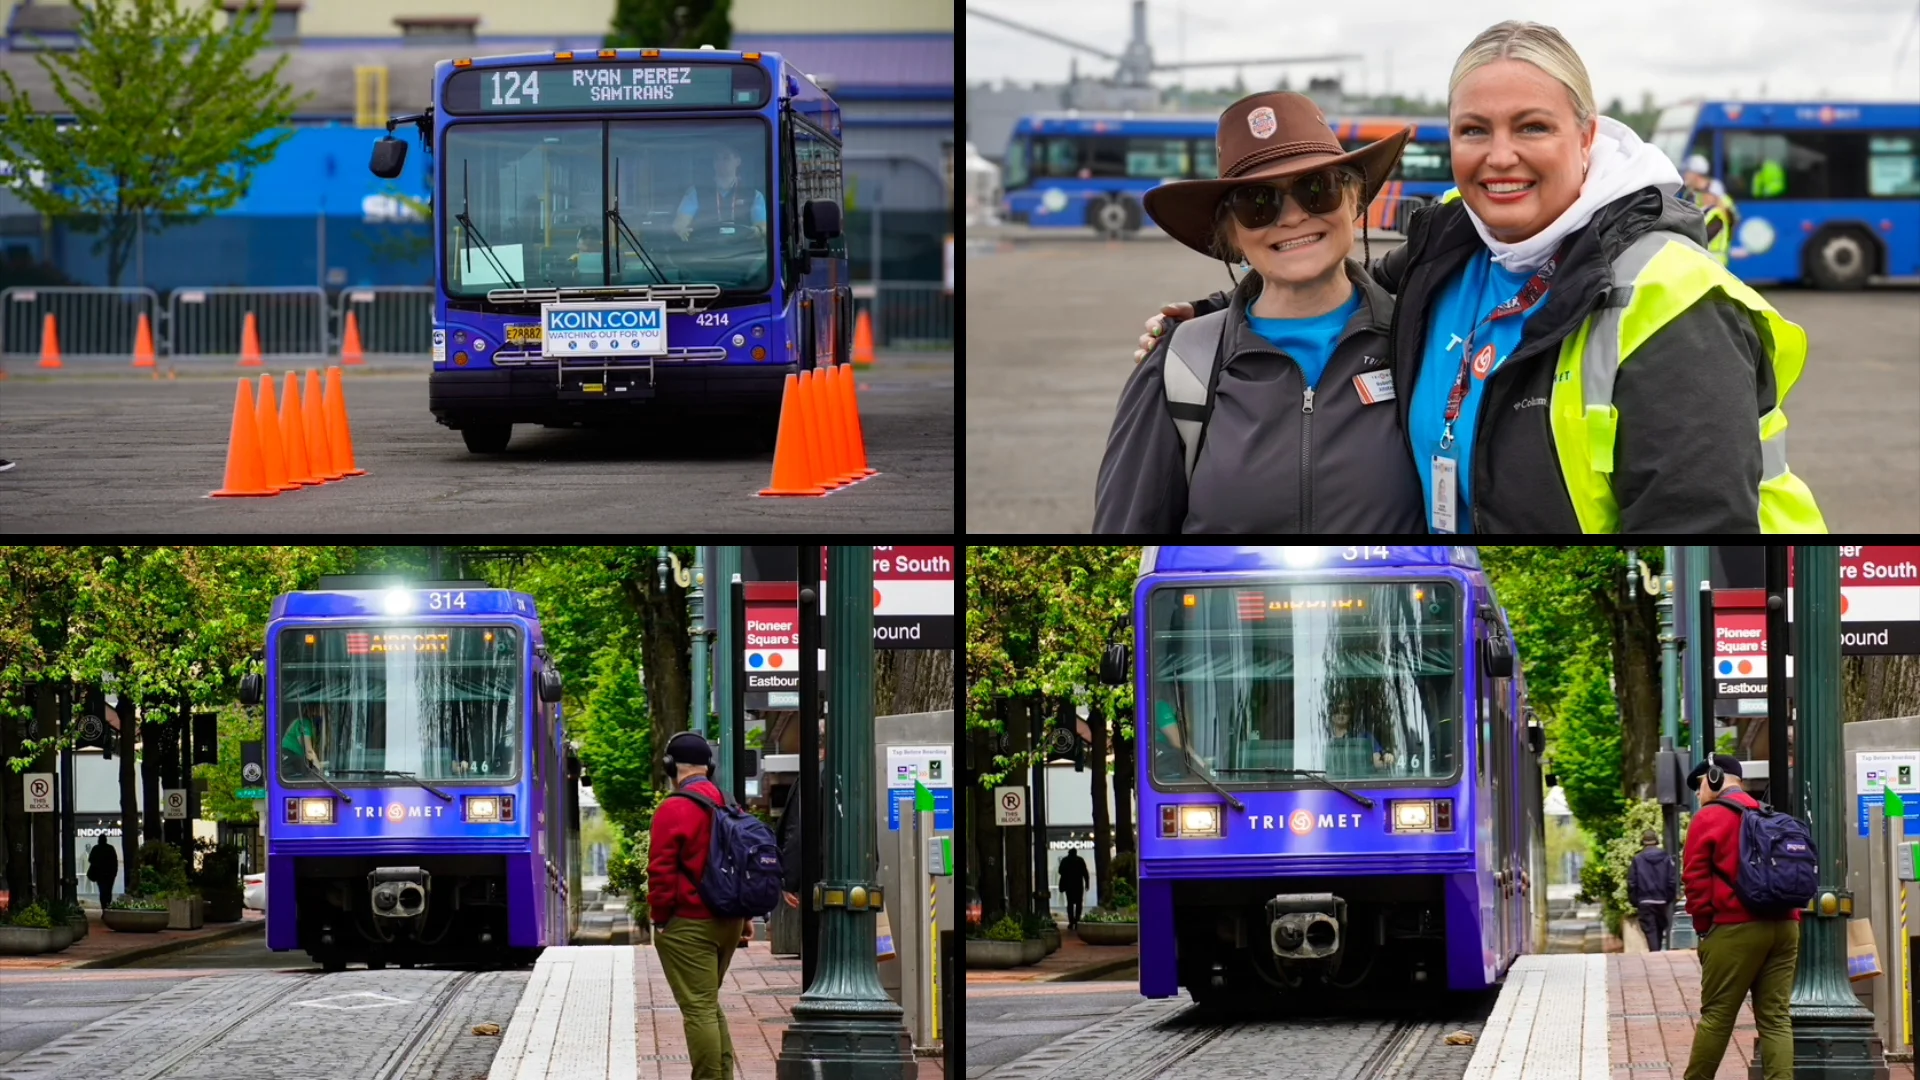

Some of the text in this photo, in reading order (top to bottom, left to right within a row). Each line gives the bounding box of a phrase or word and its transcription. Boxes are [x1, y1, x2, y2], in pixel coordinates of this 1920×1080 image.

[572, 67, 692, 86] RYAN PEREZ
[491, 70, 539, 105] 124
[590, 85, 674, 101] SAMTRANS
[551, 310, 656, 329] KOIN.COM
[696, 313, 729, 326] 4214
[548, 330, 659, 339] WATCHING OUT FOR YOU
[895, 554, 950, 573] South
[1862, 560, 1917, 578] South
[429, 592, 466, 610] 314
[747, 620, 793, 631] Pioneer
[1716, 627, 1762, 638] Pioneer
[369, 634, 449, 653] AIRPORT
[747, 633, 789, 647] Square
[1716, 640, 1759, 654] Square
[749, 675, 799, 687] Eastbou
[1718, 682, 1768, 694] Eastbou
[354, 805, 443, 818] TRI MET
[1248, 813, 1362, 829] TRI MET
